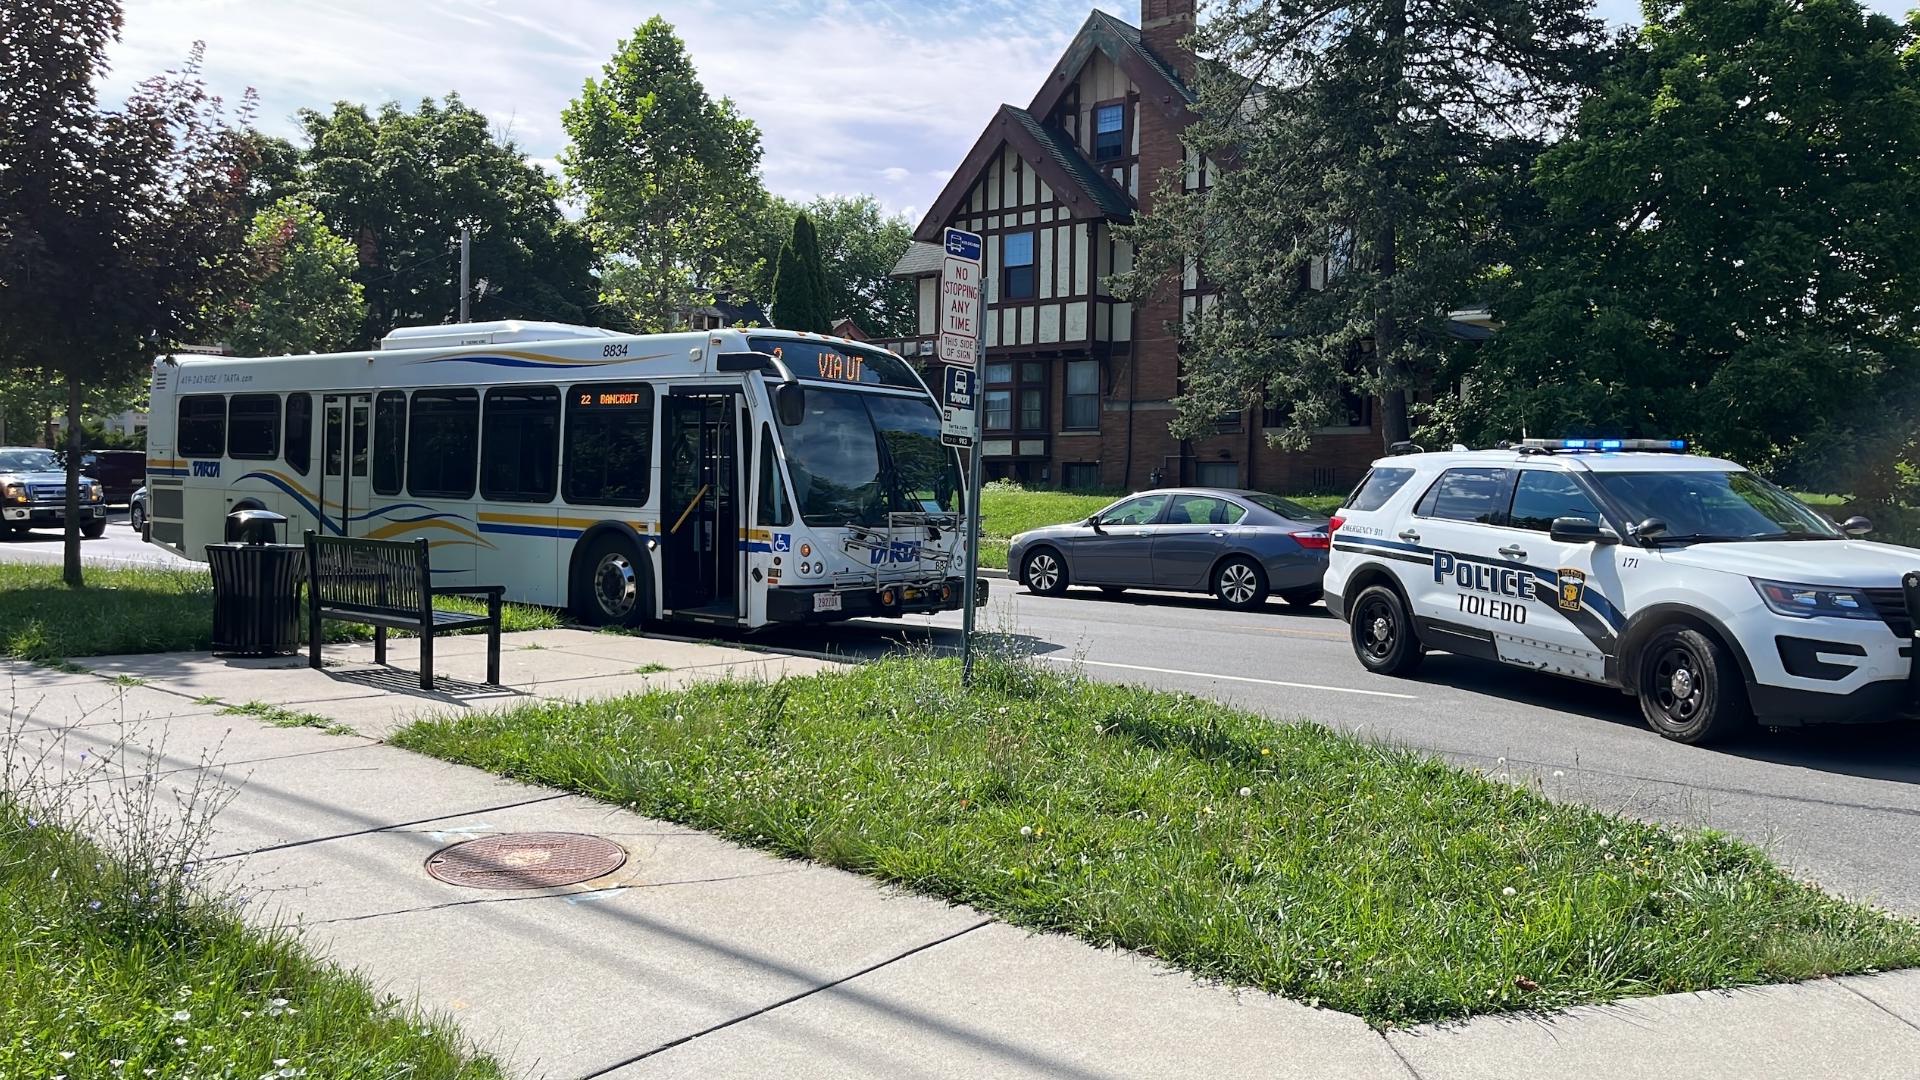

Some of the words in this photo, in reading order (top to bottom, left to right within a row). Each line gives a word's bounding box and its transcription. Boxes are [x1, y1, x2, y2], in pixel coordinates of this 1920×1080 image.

[956, 266, 968, 280] NO
[945, 281, 977, 300] STOPPING
[951, 299, 970, 314] ANY
[950, 315, 970, 331] TIME
[945, 337, 958, 347] THIS
[960, 339, 973, 349] SIDE
[603, 344, 628, 357] 8834
[946, 348, 955, 357] OF
[957, 349, 971, 359] SIGN
[818, 352, 843, 379] VIA
[846, 355, 864, 381] UT
[580, 394, 591, 405] 22
[600, 393, 639, 405] BANCROFT
[944, 411, 951, 420] 22
[1342, 525, 1372, 535] EMERGENCY
[1374, 527, 1383, 536] 911
[1622, 557, 1639, 568] 171
[1457, 593, 1527, 624] TOLEDO
